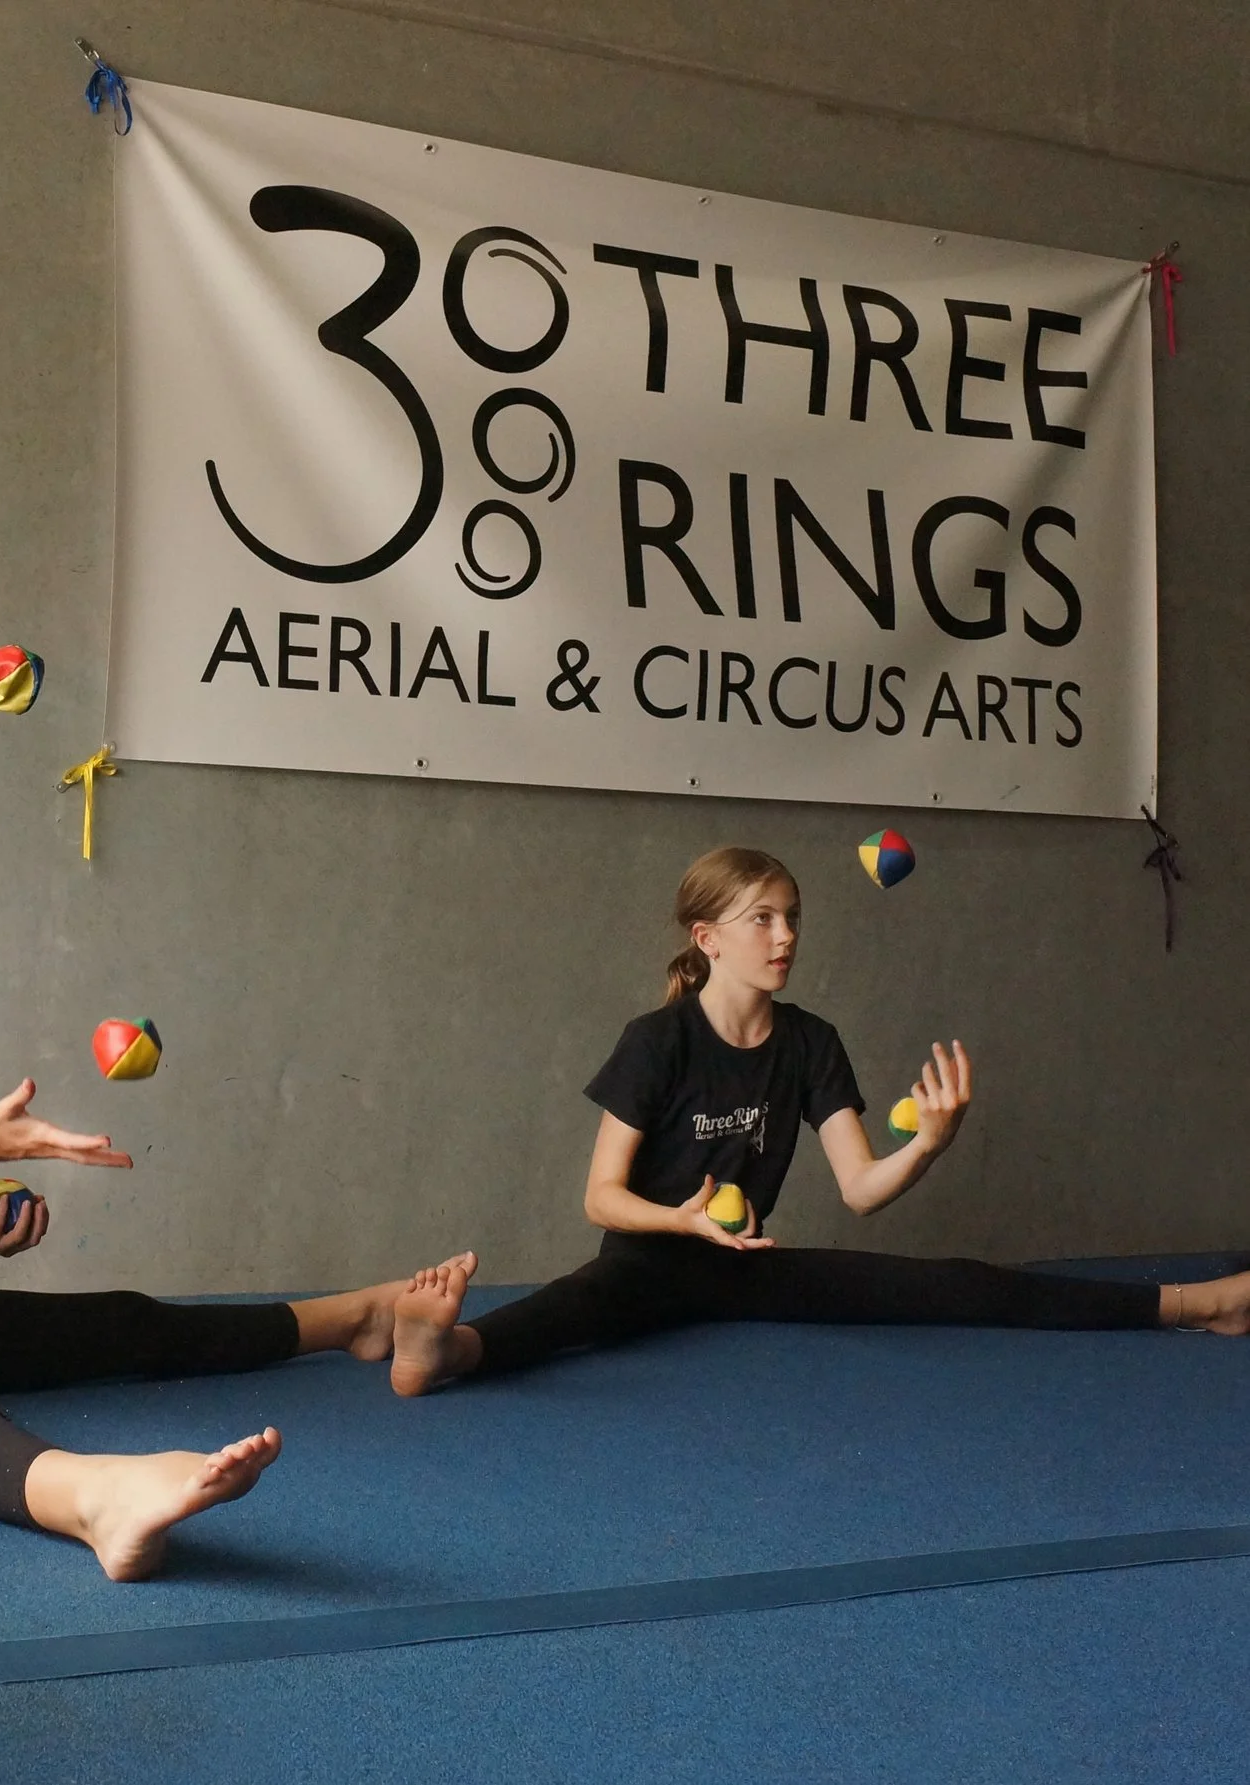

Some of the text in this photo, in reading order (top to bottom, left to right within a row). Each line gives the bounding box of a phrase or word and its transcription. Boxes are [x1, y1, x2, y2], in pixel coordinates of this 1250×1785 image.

[206, 185, 444, 584] 3
[593, 243, 1088, 449] THREE
[619, 459, 1082, 647] RINGS
[201, 608, 1082, 748] AERIAL & CIRCUS ARTS
[692, 1102, 769, 1132] Three Rins
